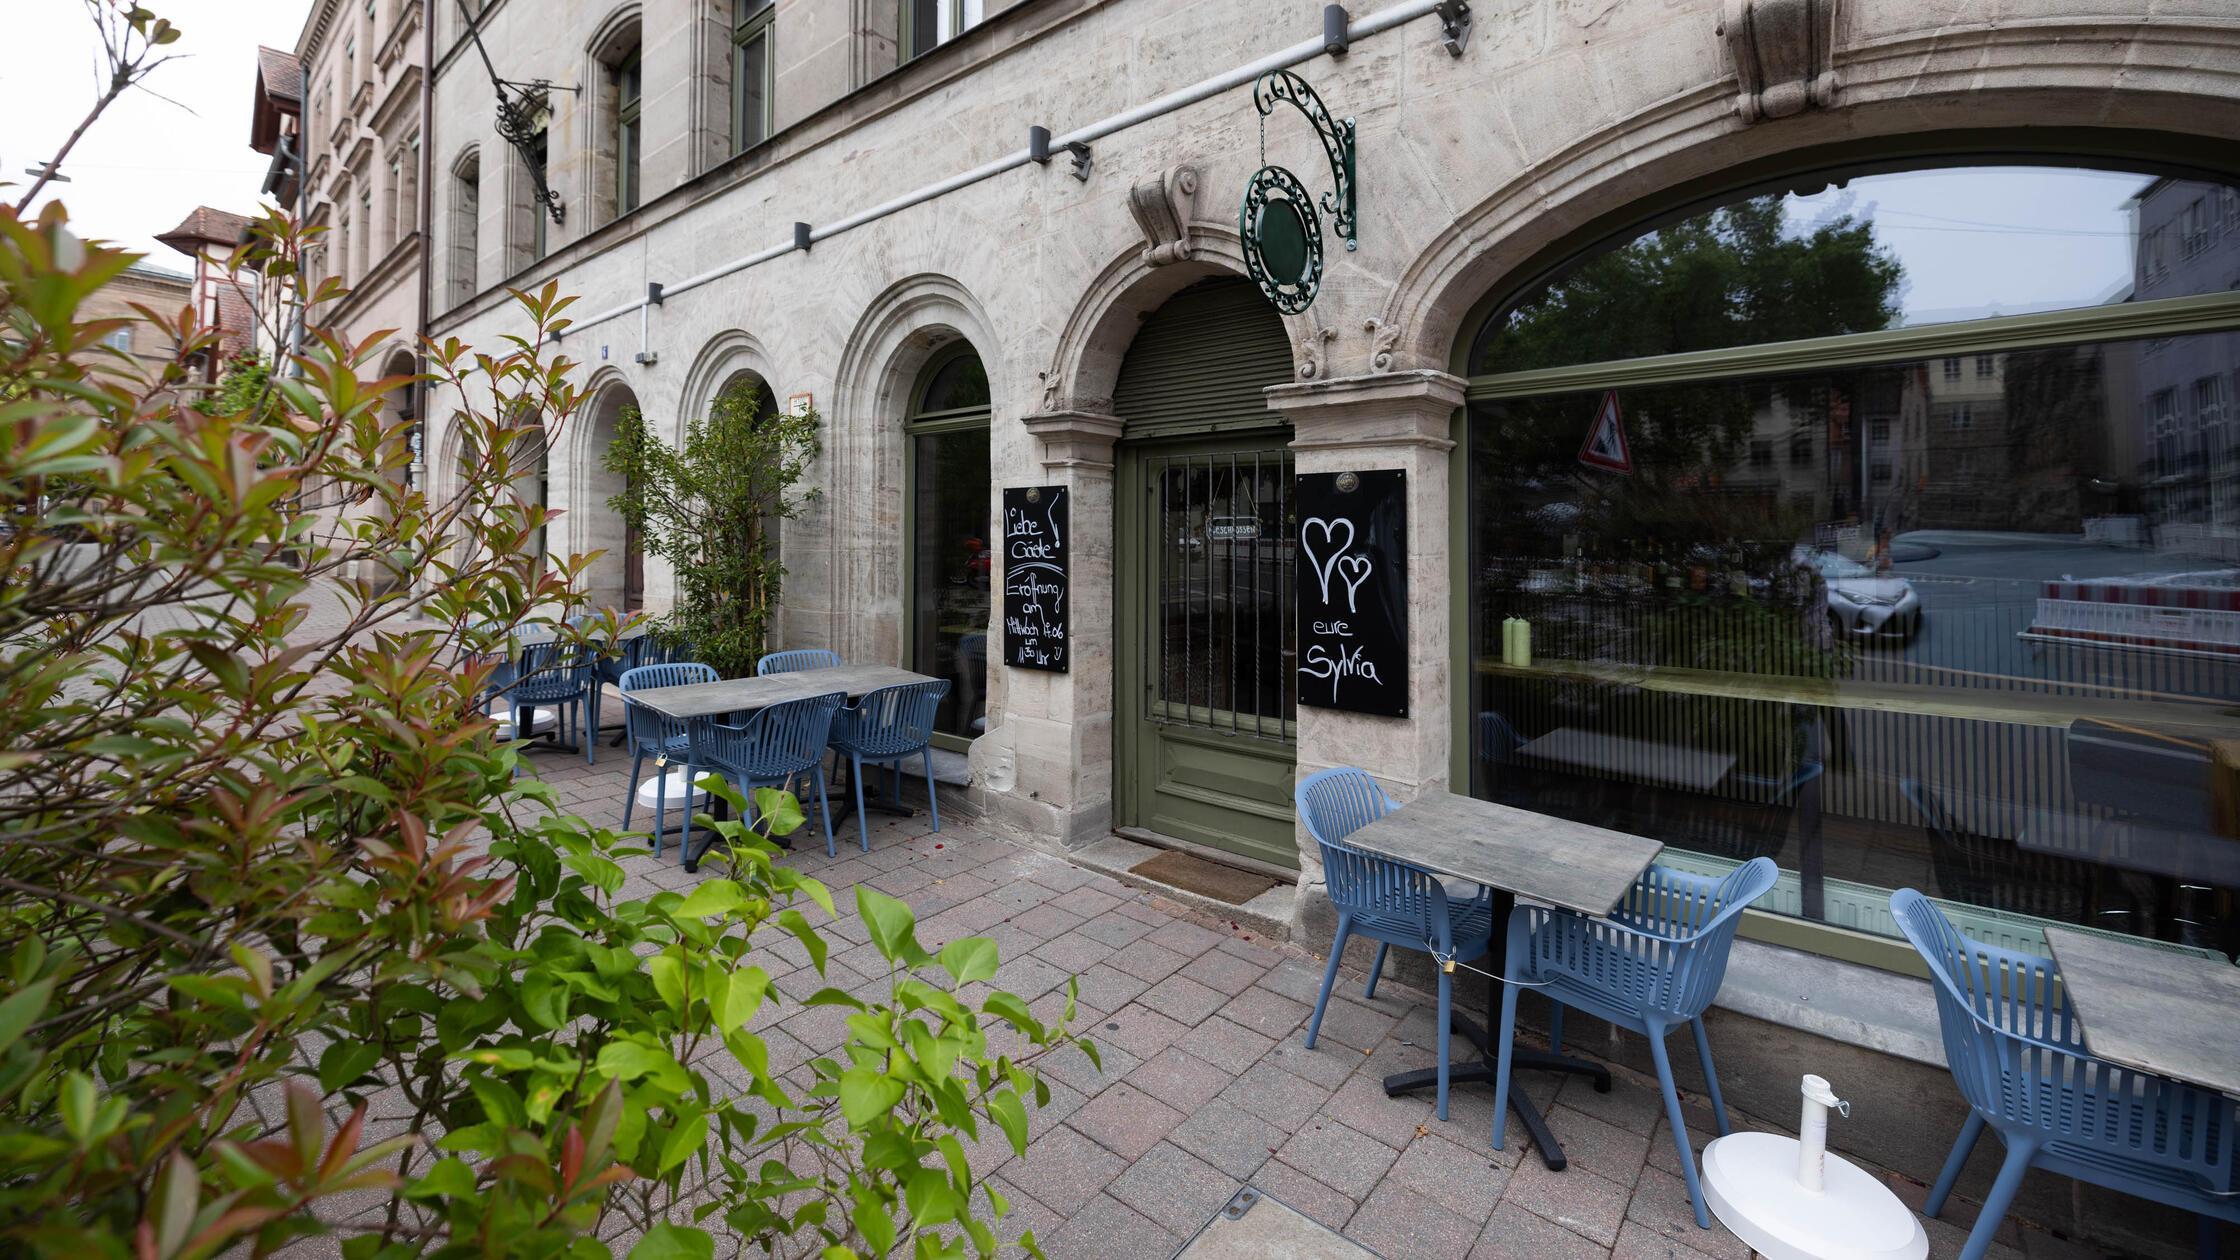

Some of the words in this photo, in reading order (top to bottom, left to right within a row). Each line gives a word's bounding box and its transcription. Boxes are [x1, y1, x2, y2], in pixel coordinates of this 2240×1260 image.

[1004, 507, 1043, 538] Liebe
[1006, 615, 1040, 637] Mittwoch
[1312, 619, 1354, 637] eure
[1024, 637, 1038, 648] um
[1036, 648, 1050, 667] Uhr
[1297, 643, 1384, 705] Sylvia
